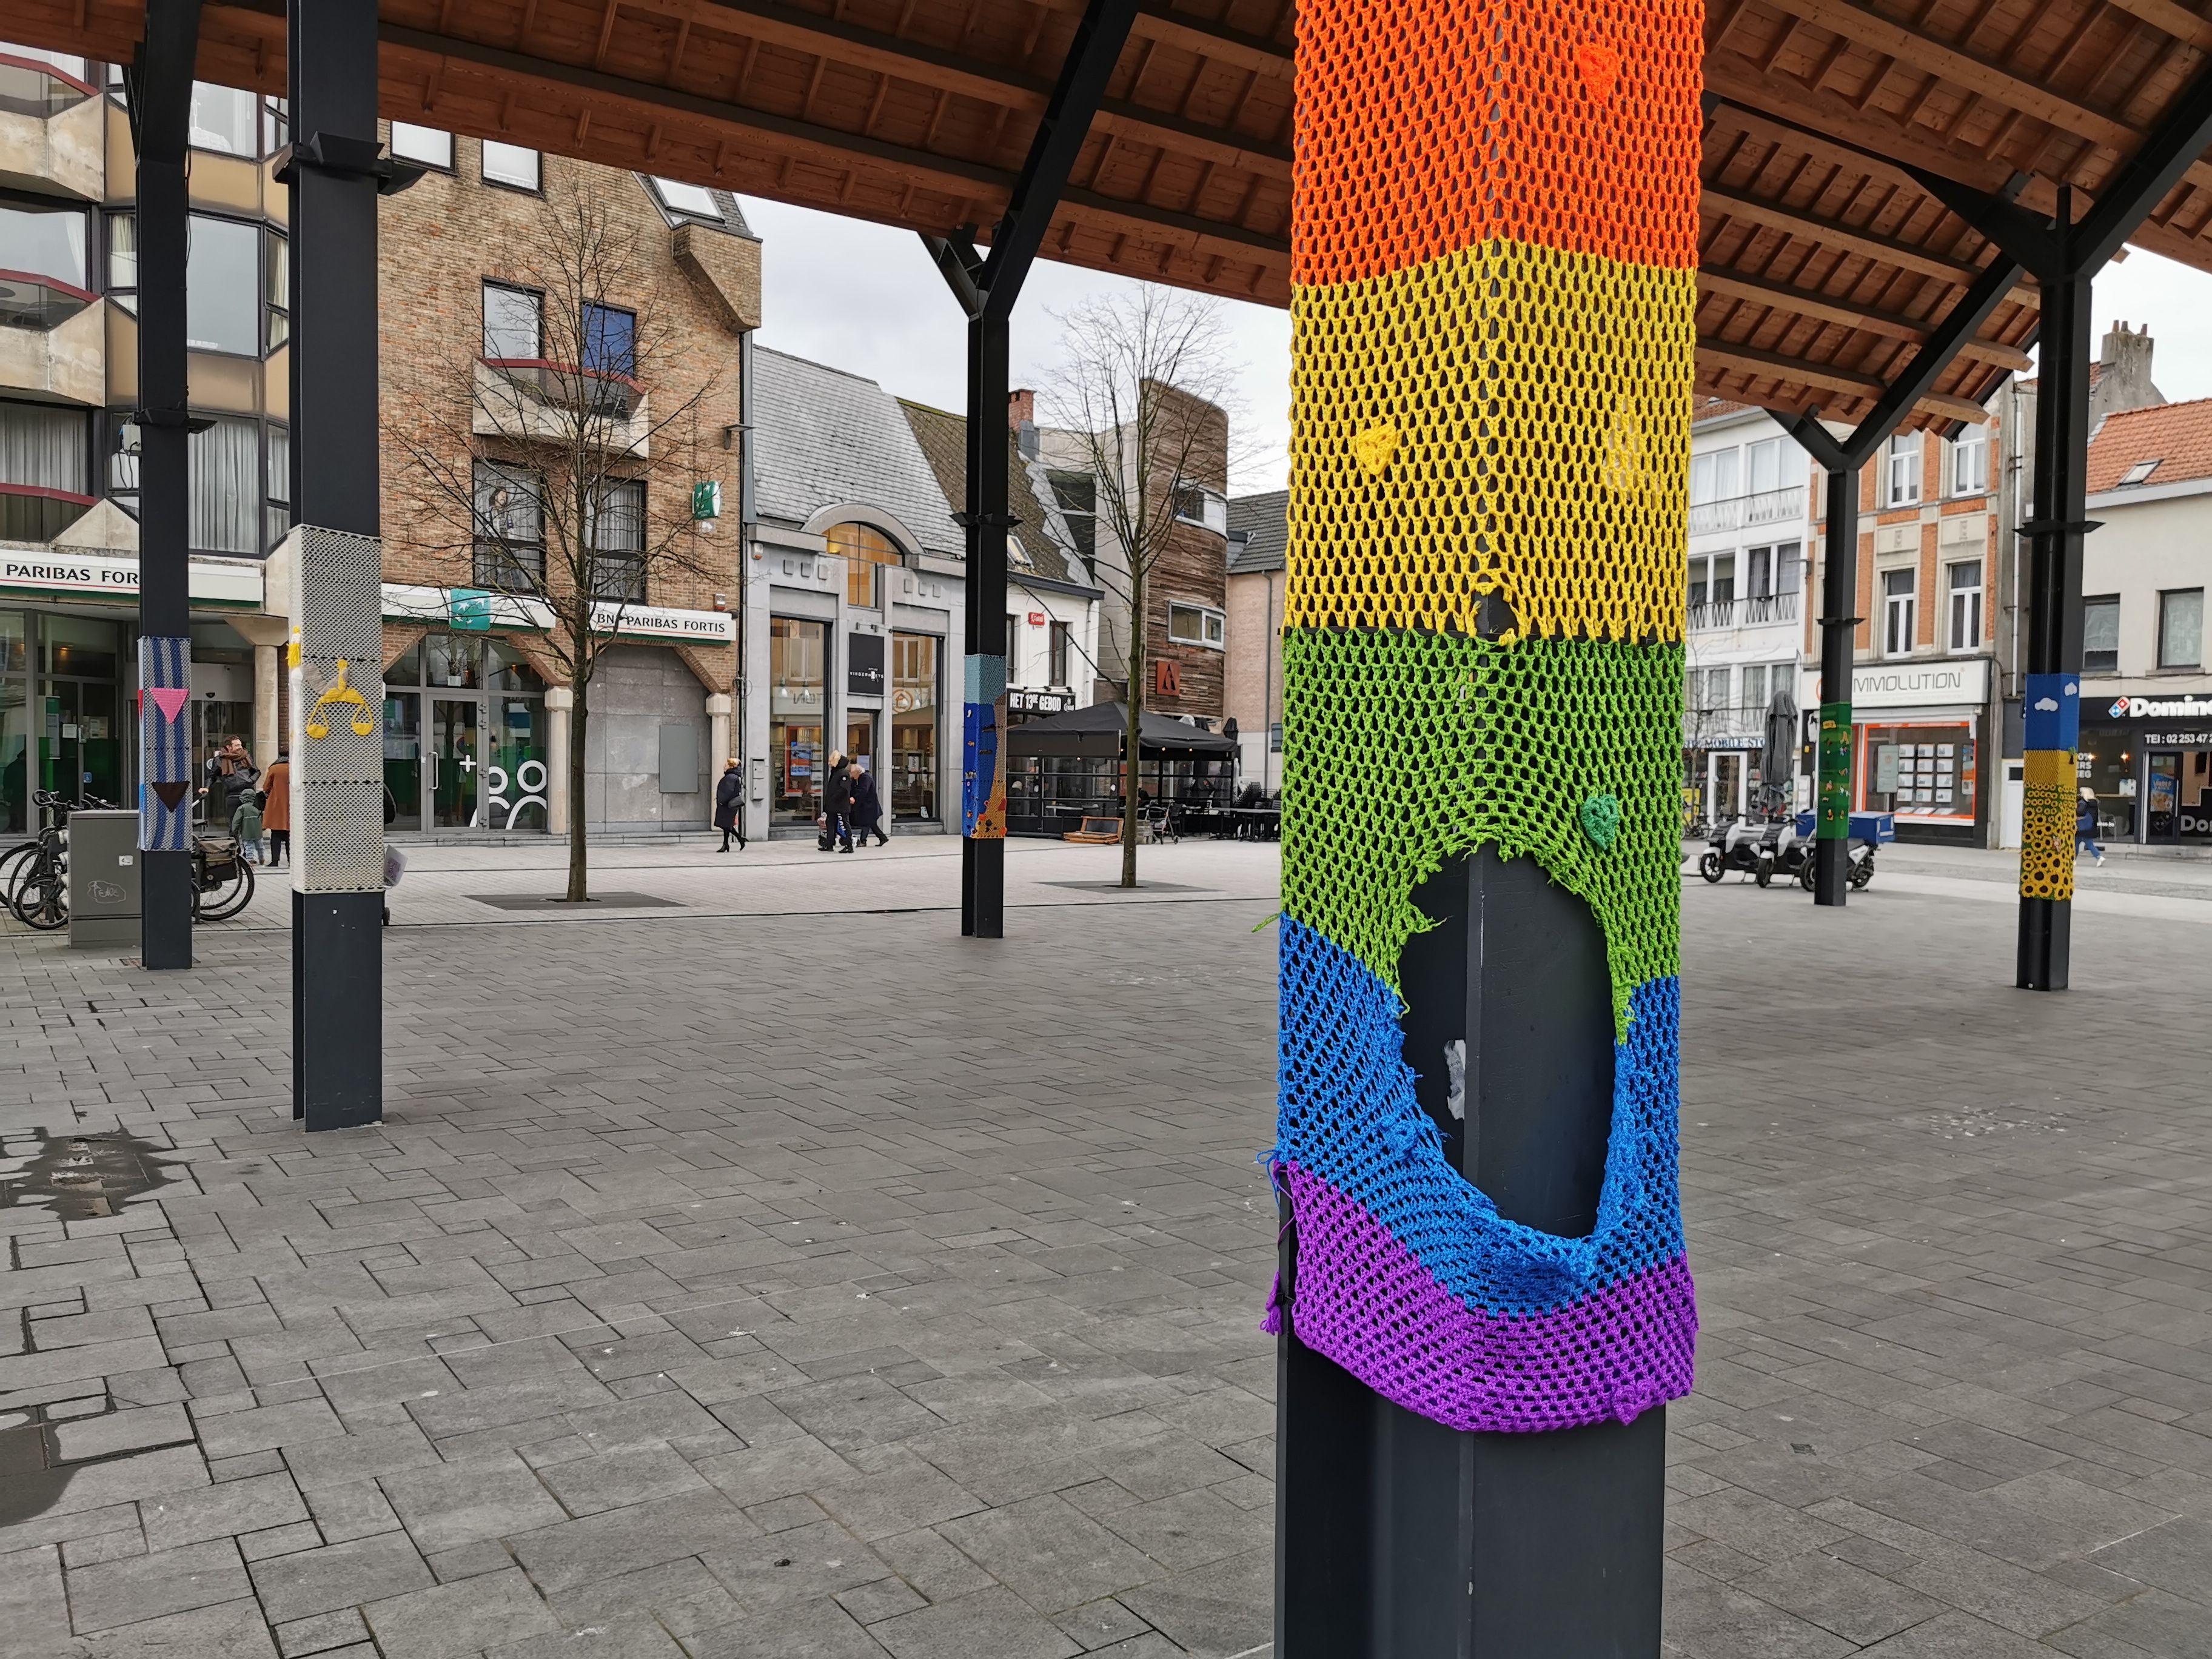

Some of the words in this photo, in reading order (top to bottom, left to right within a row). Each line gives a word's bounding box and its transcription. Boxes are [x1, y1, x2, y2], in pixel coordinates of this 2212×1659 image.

[7, 564, 91, 581] PARIBAS
[626, 616, 678, 629] PARIBAS
[685, 620, 725, 632] FORTIS
[1010, 692, 1025, 709] HET
[1039, 695, 1062, 712] GEBOD
[1705, 738, 1744, 748] MOBILE
[2166, 734, 2177, 744] 02
[2179, 734, 2195, 744] 253
[2196, 733, 2208, 743] 47
[2180, 815, 2212, 833] Do
